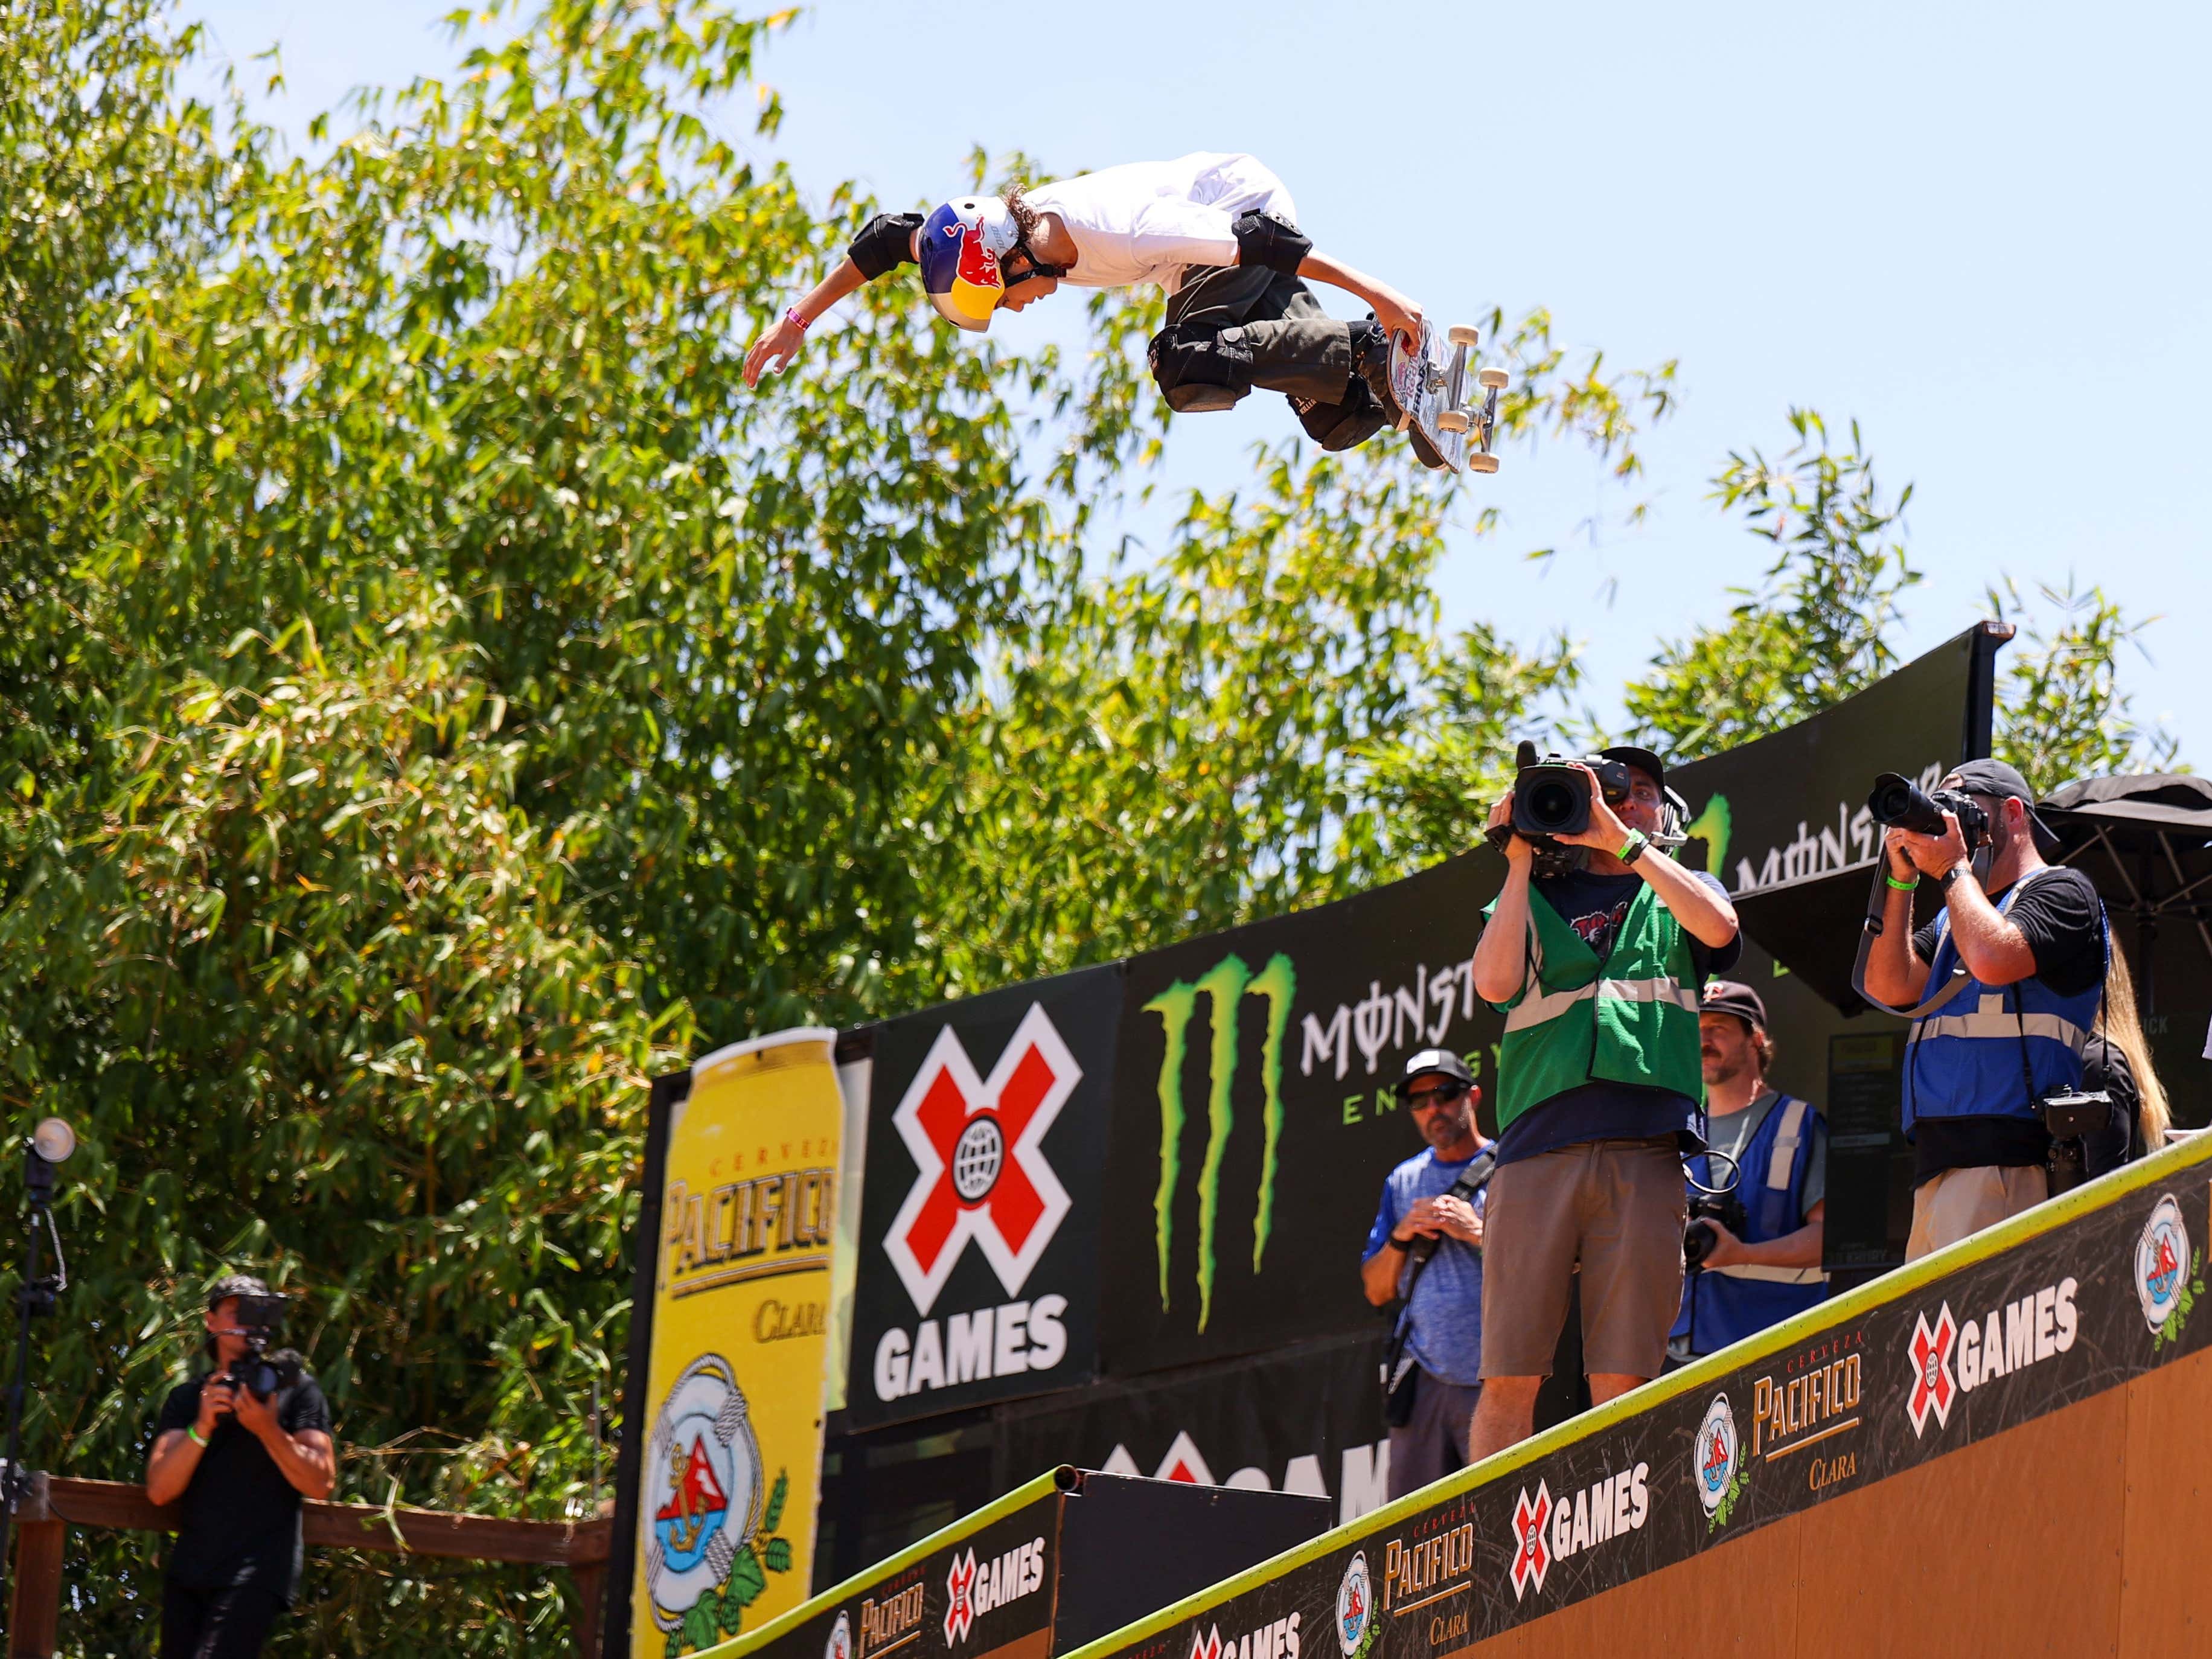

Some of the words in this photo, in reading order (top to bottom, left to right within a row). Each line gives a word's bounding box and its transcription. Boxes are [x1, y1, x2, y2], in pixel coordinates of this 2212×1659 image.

[1299, 398, 1317, 415] KILLER
[1300, 959, 1475, 1081] MONST
[1343, 1043, 1501, 1125] ENGY
[874, 1294, 1069, 1402] GAMES
[1786, 1331, 1862, 1373] CERVEZA
[1957, 1276, 2078, 1393] GAMES
[1753, 1352, 1861, 1457] PACIFICO
[1809, 1451, 1857, 1491] CLARA
[1413, 1501, 1475, 1538] CERVEZA
[1552, 1462, 1649, 1562] GAMES
[973, 1536, 1045, 1617] GAMES
[1382, 1522, 1474, 1612] PACIFICO
[859, 1582, 924, 1659] PACIFICO
[1430, 1611, 1469, 1646] CLARA
